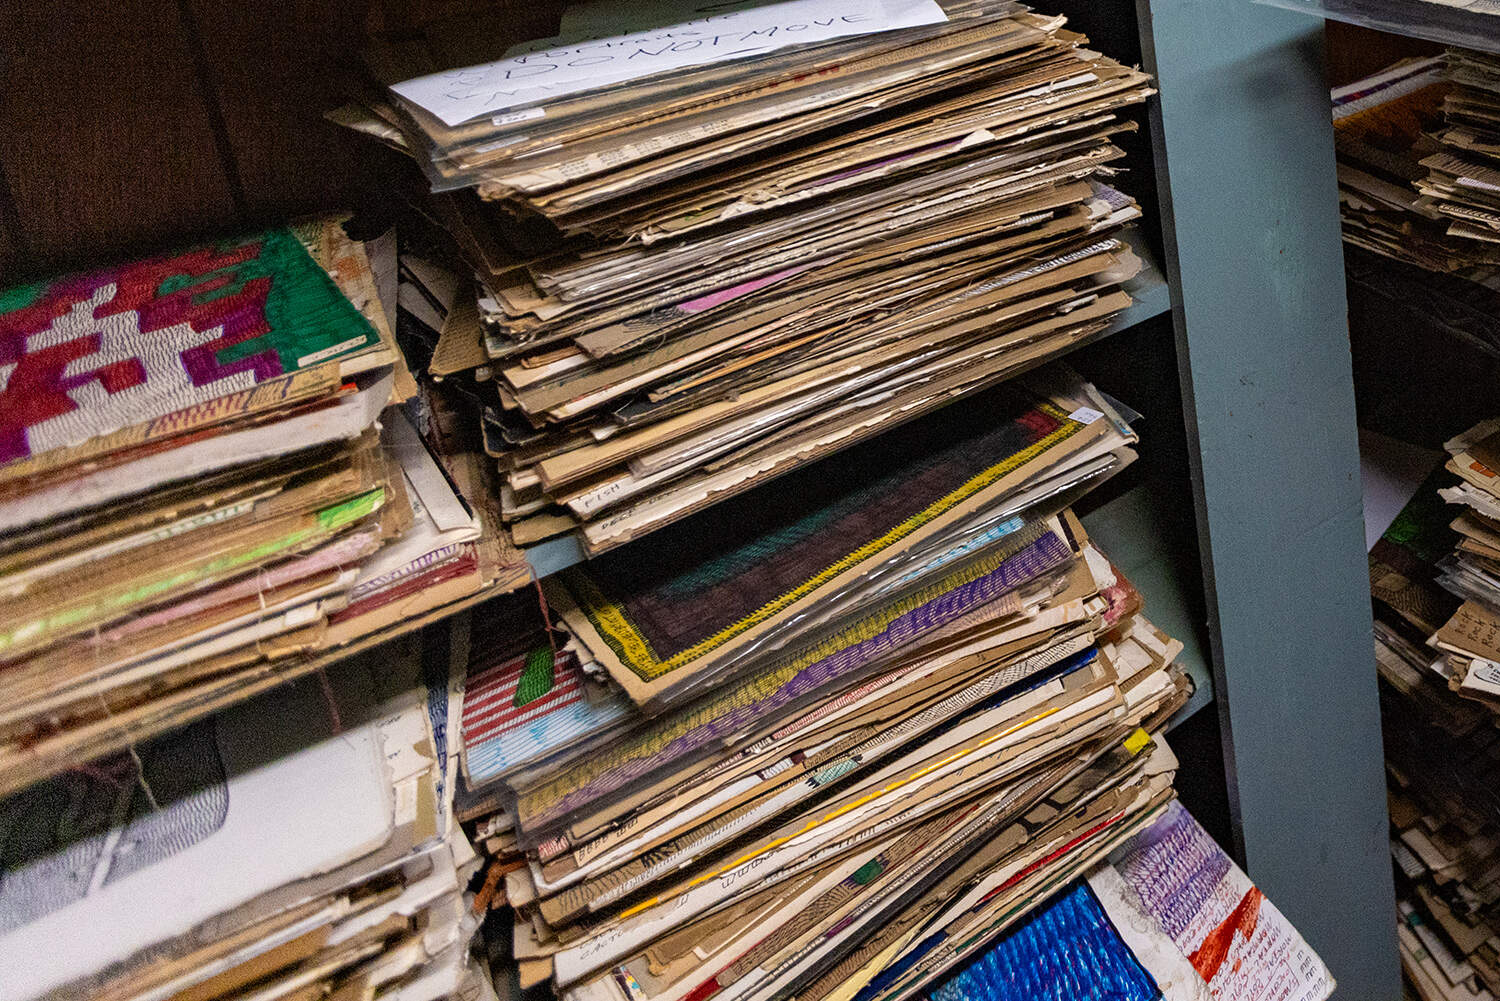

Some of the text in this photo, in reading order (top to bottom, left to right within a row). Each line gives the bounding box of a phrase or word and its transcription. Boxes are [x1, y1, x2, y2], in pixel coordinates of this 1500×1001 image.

[506, 55, 615, 79] DO
[628, 31, 740, 60] NOT
[740, 12, 874, 42] MOVE
